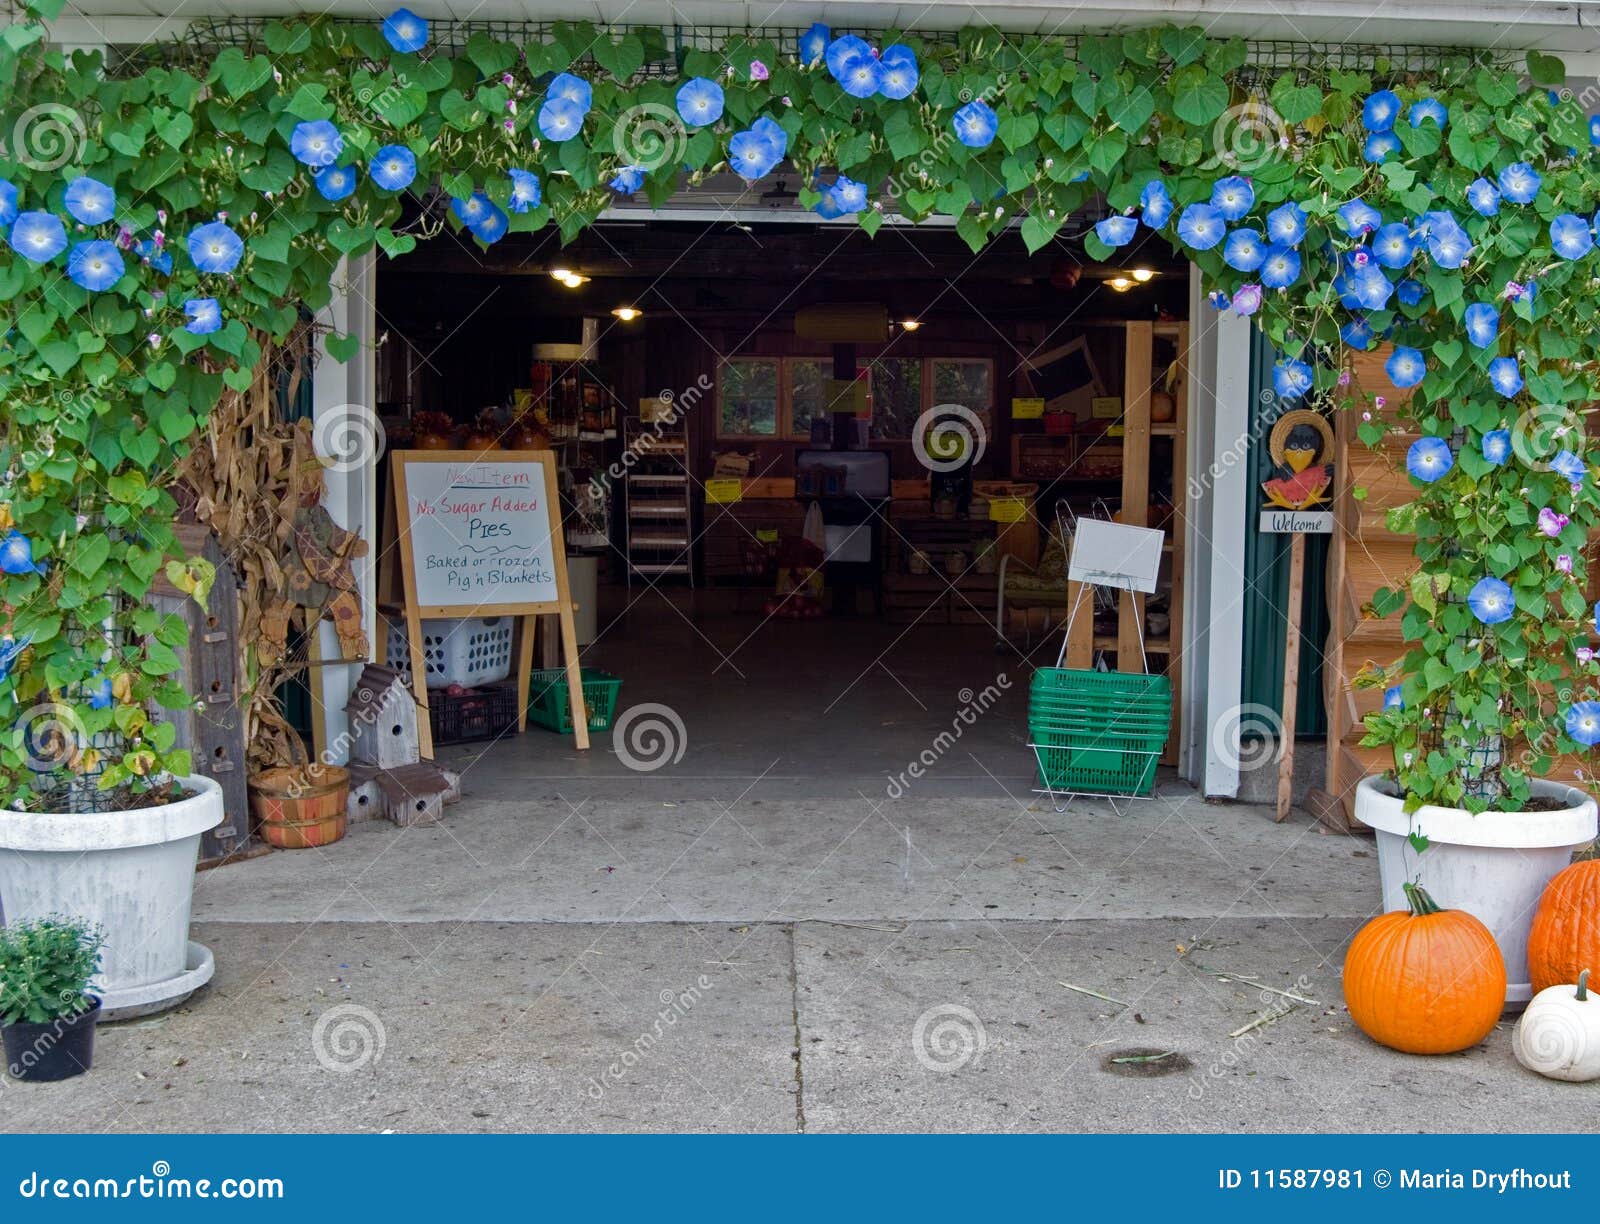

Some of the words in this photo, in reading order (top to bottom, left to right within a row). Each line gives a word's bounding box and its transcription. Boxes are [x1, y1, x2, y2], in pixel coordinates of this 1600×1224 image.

[476, 466, 530, 485] Item
[416, 499, 436, 515] No
[440, 496, 487, 522] Sugar
[491, 495, 537, 513] Added
[1272, 513, 1322, 531] Welcome
[425, 554, 467, 569] Baked
[472, 558, 484, 567] or
[447, 570, 471, 591] Pig
[487, 569, 552, 584] Blankets
